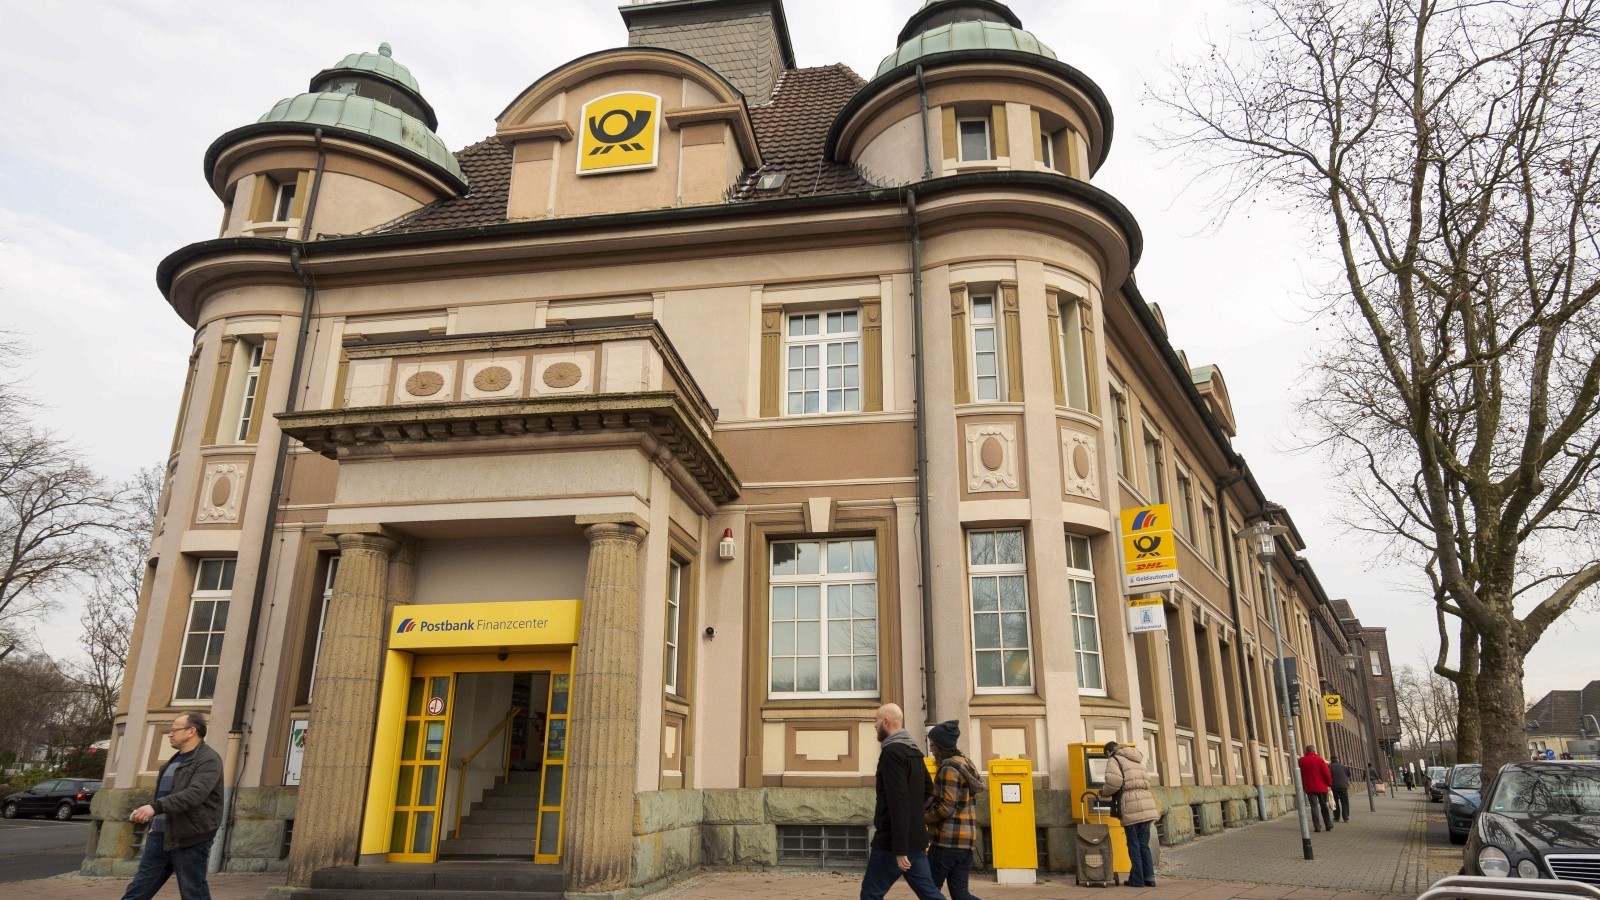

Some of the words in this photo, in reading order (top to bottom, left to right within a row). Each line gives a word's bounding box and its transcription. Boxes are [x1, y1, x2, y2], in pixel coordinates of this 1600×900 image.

[1135, 562, 1164, 571] DHL
[1135, 573, 1174, 582] Geldautomat
[420, 619, 474, 632] Postbank
[476, 618, 549, 631] Finanzcenter
